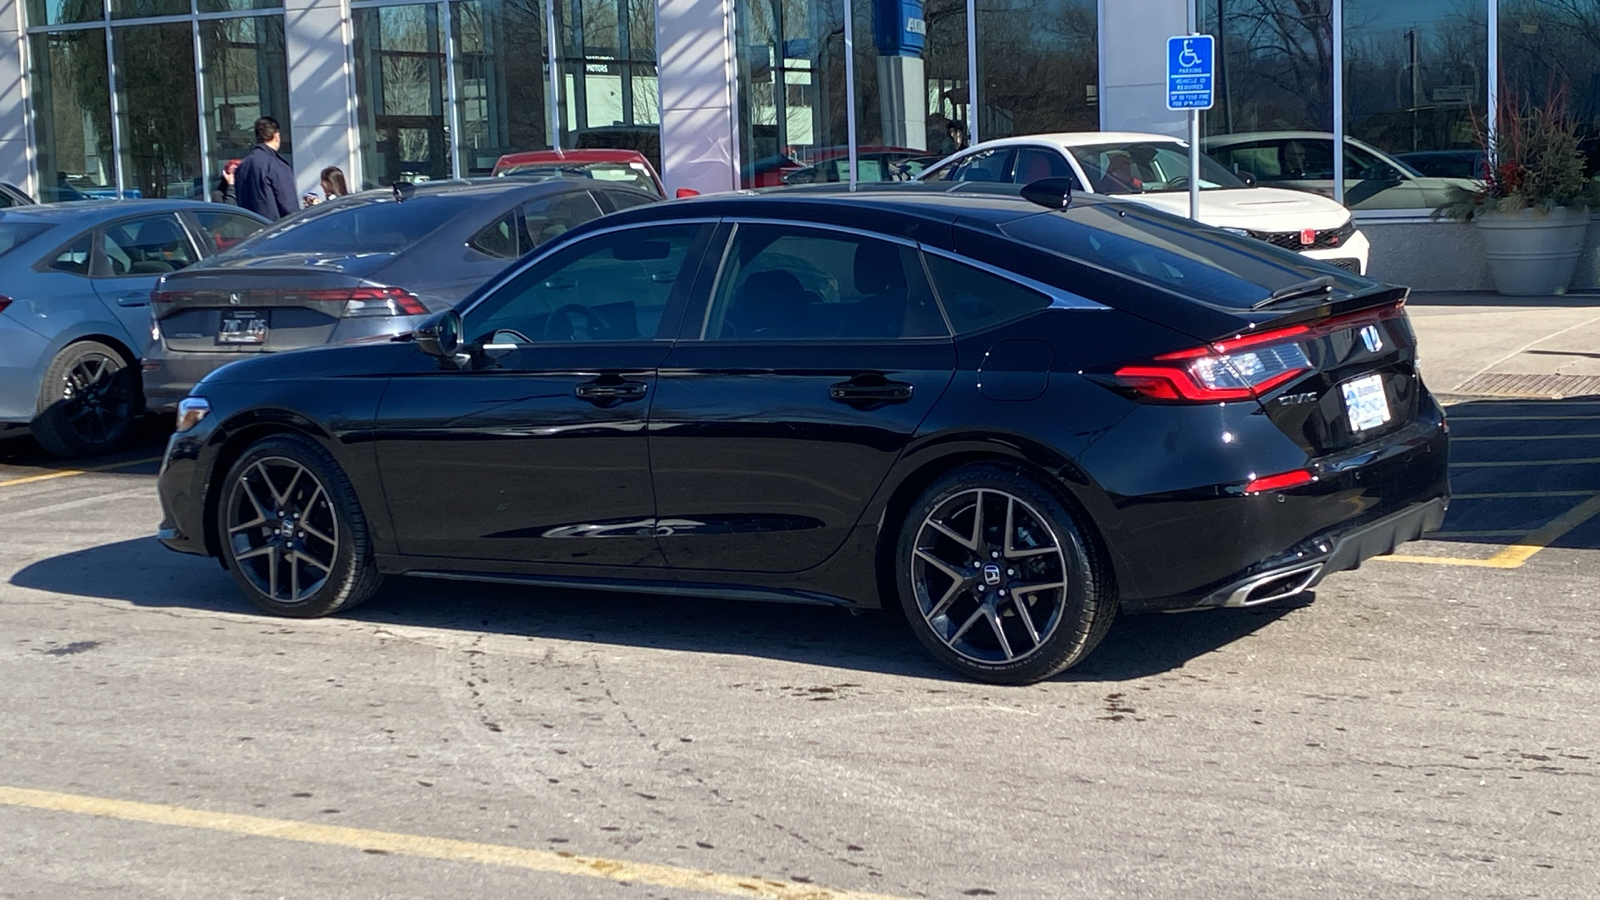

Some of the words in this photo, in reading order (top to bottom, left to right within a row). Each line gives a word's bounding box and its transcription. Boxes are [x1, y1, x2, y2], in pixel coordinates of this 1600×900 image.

[586, 64, 608, 73] MOTORS
[1278, 391, 1317, 405] CIVIC
[1360, 396, 1385, 413] HONDA
